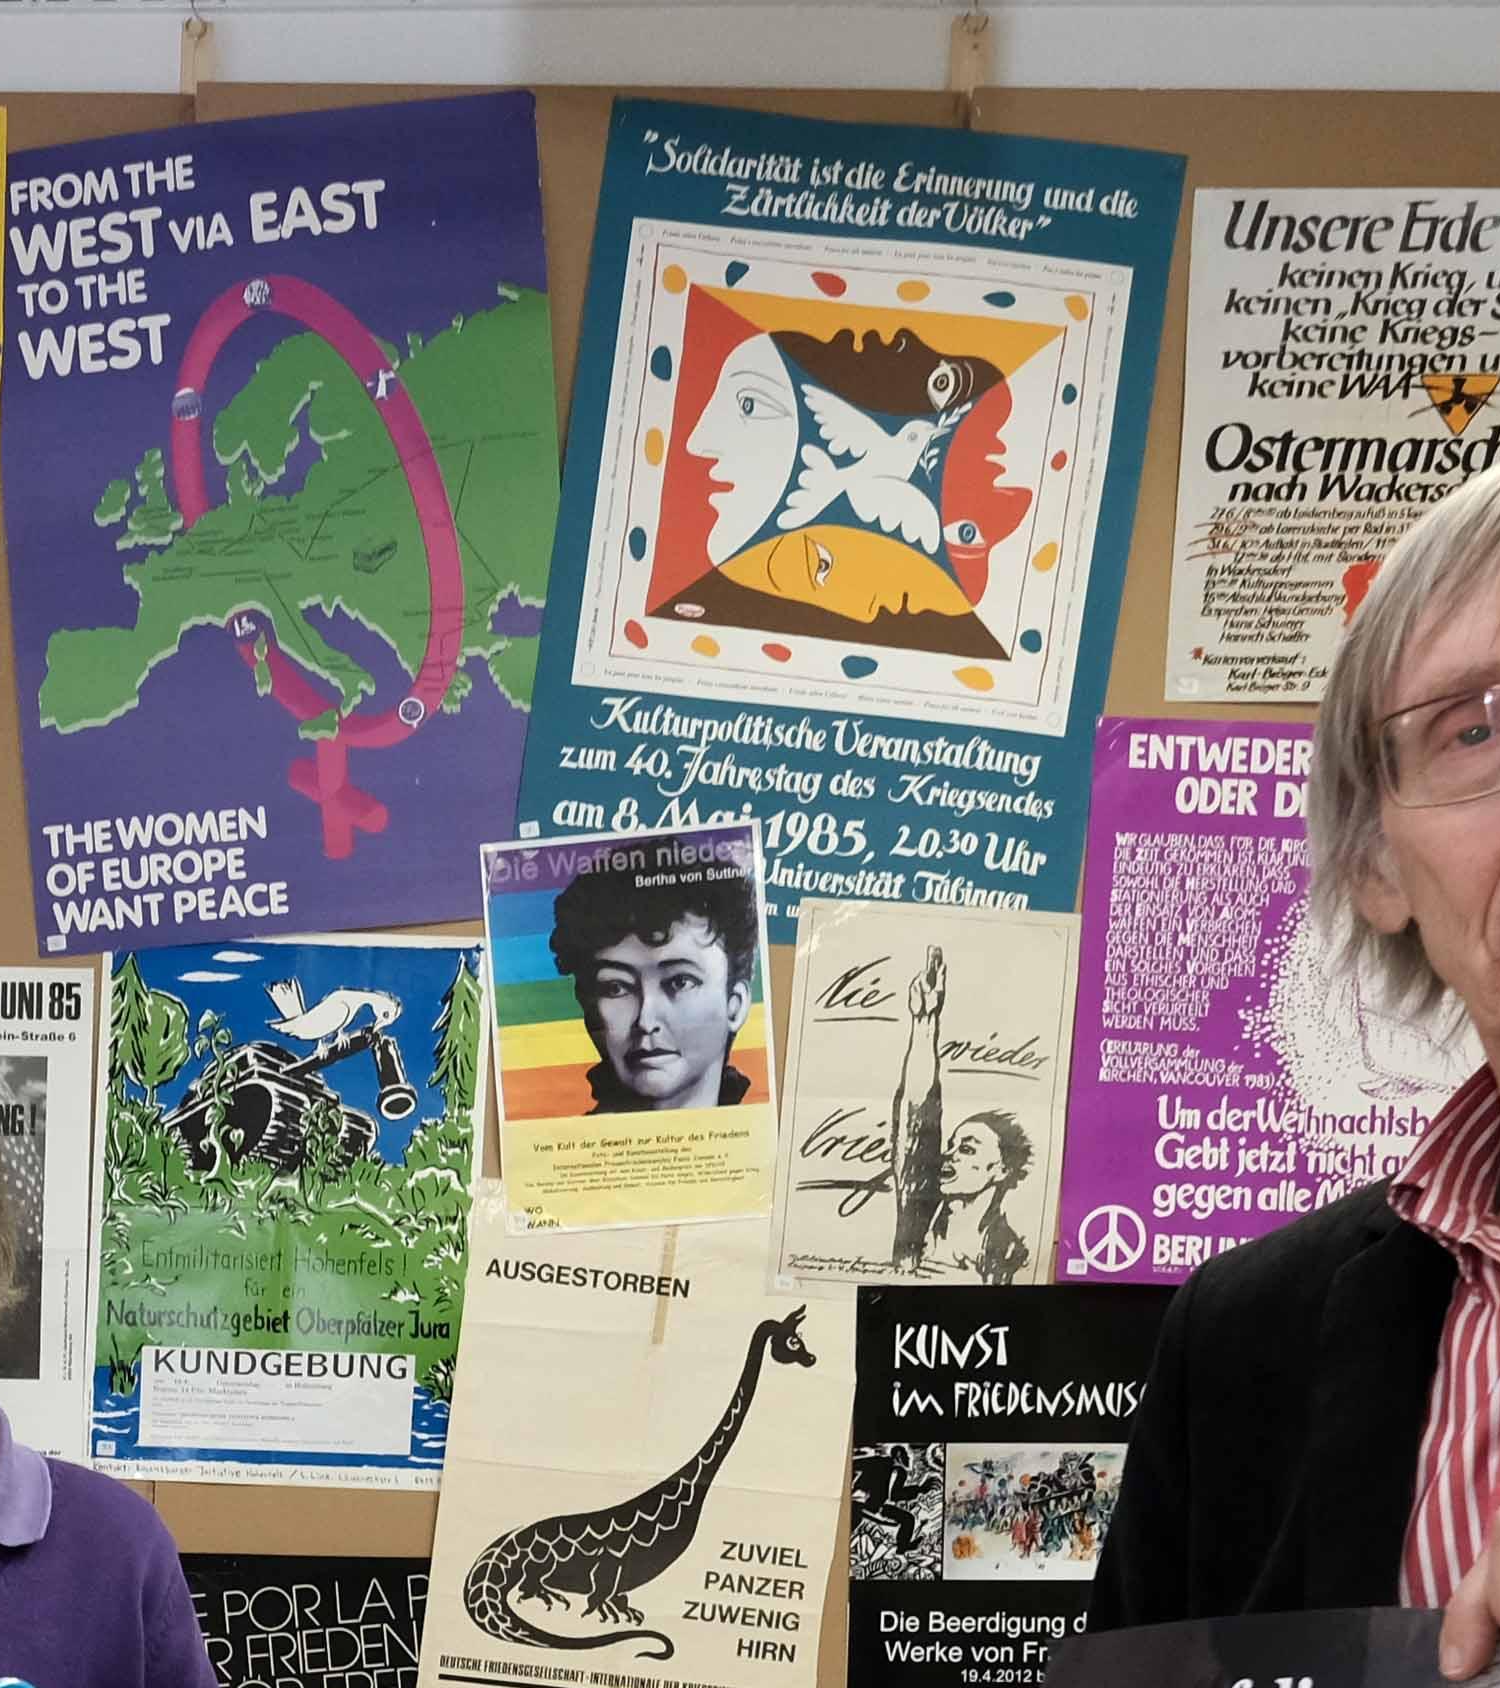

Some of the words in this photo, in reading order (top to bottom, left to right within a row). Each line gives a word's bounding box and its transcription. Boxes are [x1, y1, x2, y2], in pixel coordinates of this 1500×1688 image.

[9, 207, 162, 276] WEST
[168, 213, 234, 253] VIA
[249, 179, 386, 244] EAST
[1222, 200, 1391, 256] Unsere
[590, 695, 826, 754] Kulturpolitische
[833, 718, 1041, 786] Veranstaltung
[1128, 732, 1312, 778] ENTWEDER
[43, 818, 112, 860] THE
[114, 804, 269, 850] WOMEN
[46, 861, 97, 898] OF
[102, 847, 247, 893] EUROPE
[52, 892, 165, 935] WANT
[173, 880, 289, 924] PEACE
[1106, 930, 1149, 946] GEGEN
[1155, 932, 1174, 947] DIE
[1178, 933, 1259, 950] MENSCHHEIT
[152, 1348, 409, 1379] KUNDGEBUNG
[893, 1323, 1010, 1370] KUNST
[720, 1540, 810, 1569] ZUVIEL
[704, 1570, 805, 1601] PANZER
[682, 1600, 801, 1632] ZUWENIG
[736, 1638, 797, 1664] HIRN
